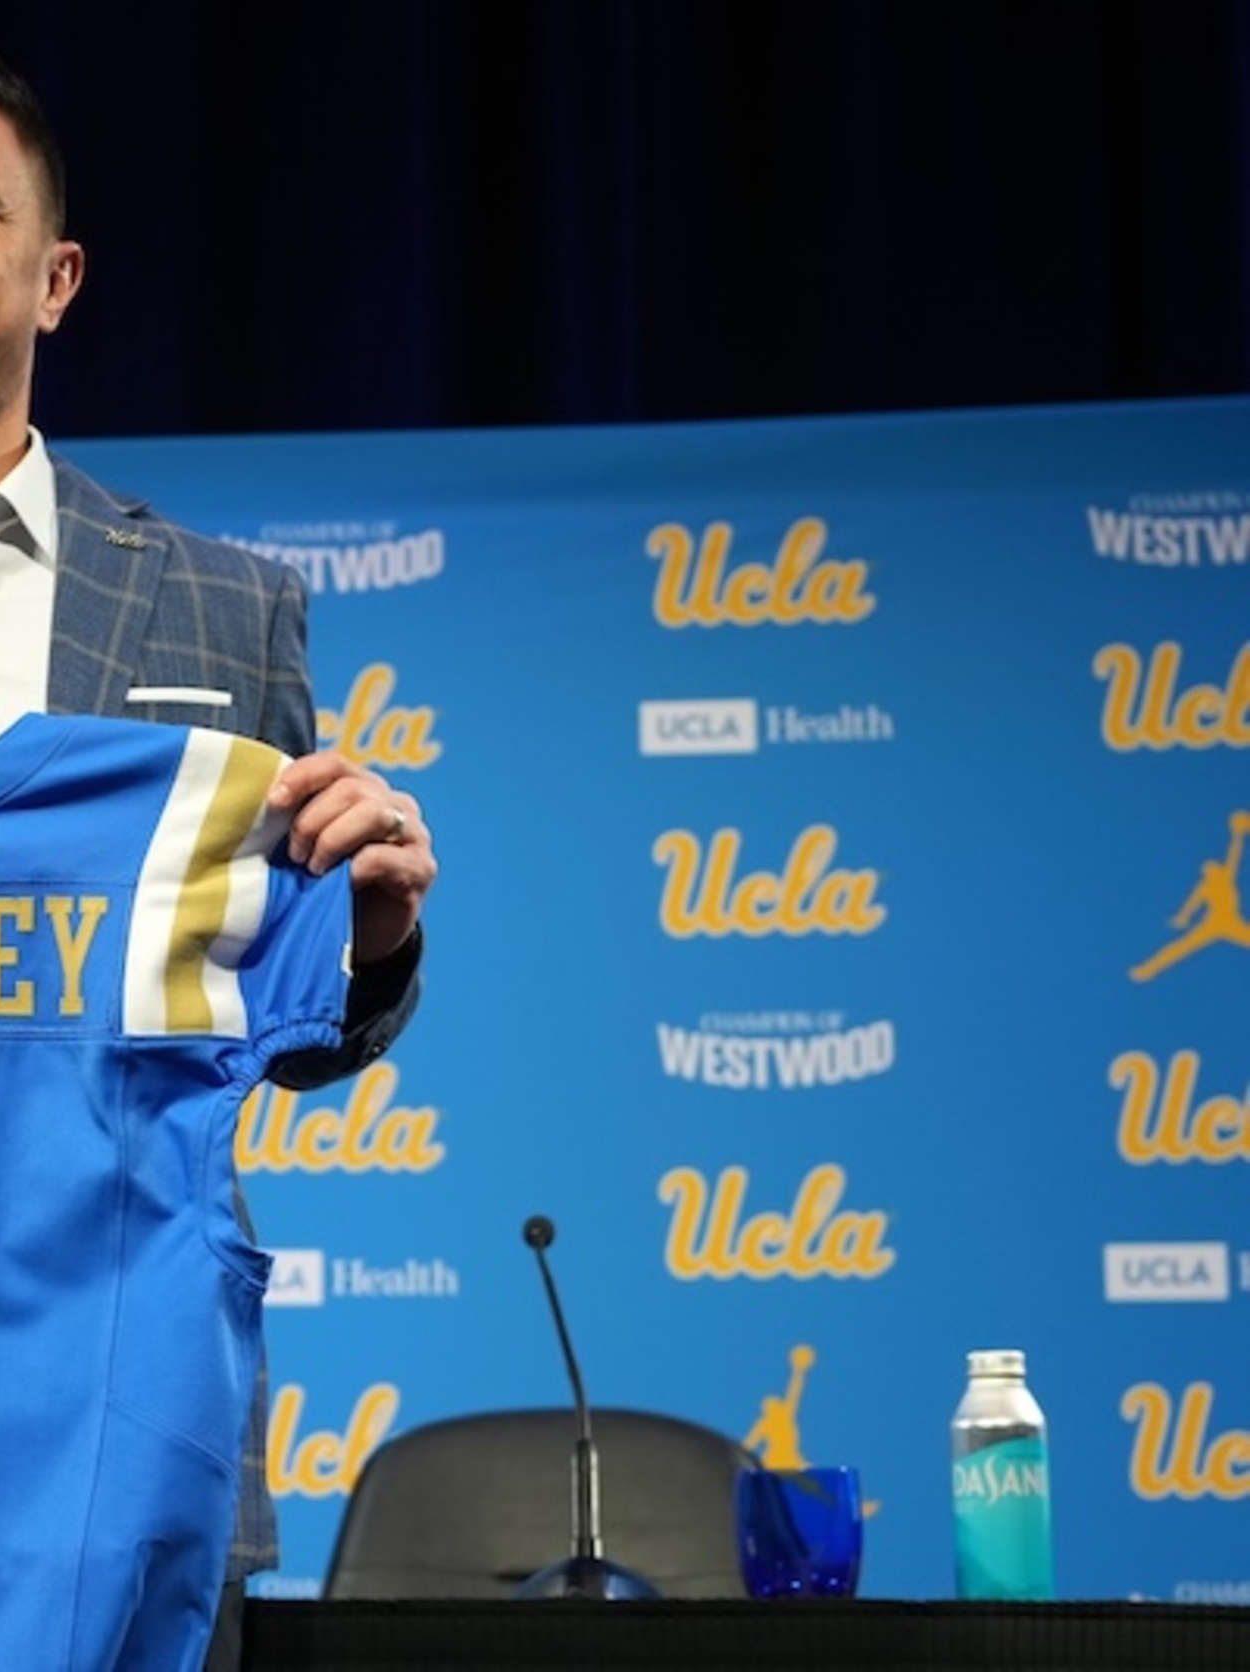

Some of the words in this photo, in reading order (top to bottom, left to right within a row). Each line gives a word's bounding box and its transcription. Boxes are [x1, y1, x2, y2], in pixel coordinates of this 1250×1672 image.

[646, 516, 877, 629] Ucla
[656, 711, 741, 743] UCLA
[765, 704, 895, 744] Health
[652, 824, 887, 939] Ucla
[656, 1018, 896, 1090] WESTWOOD
[1108, 1049, 1250, 1167] Uc
[657, 1163, 896, 1281] Ucla
[332, 1257, 460, 1297] Health
[1122, 1256, 1212, 1289] UCLA
